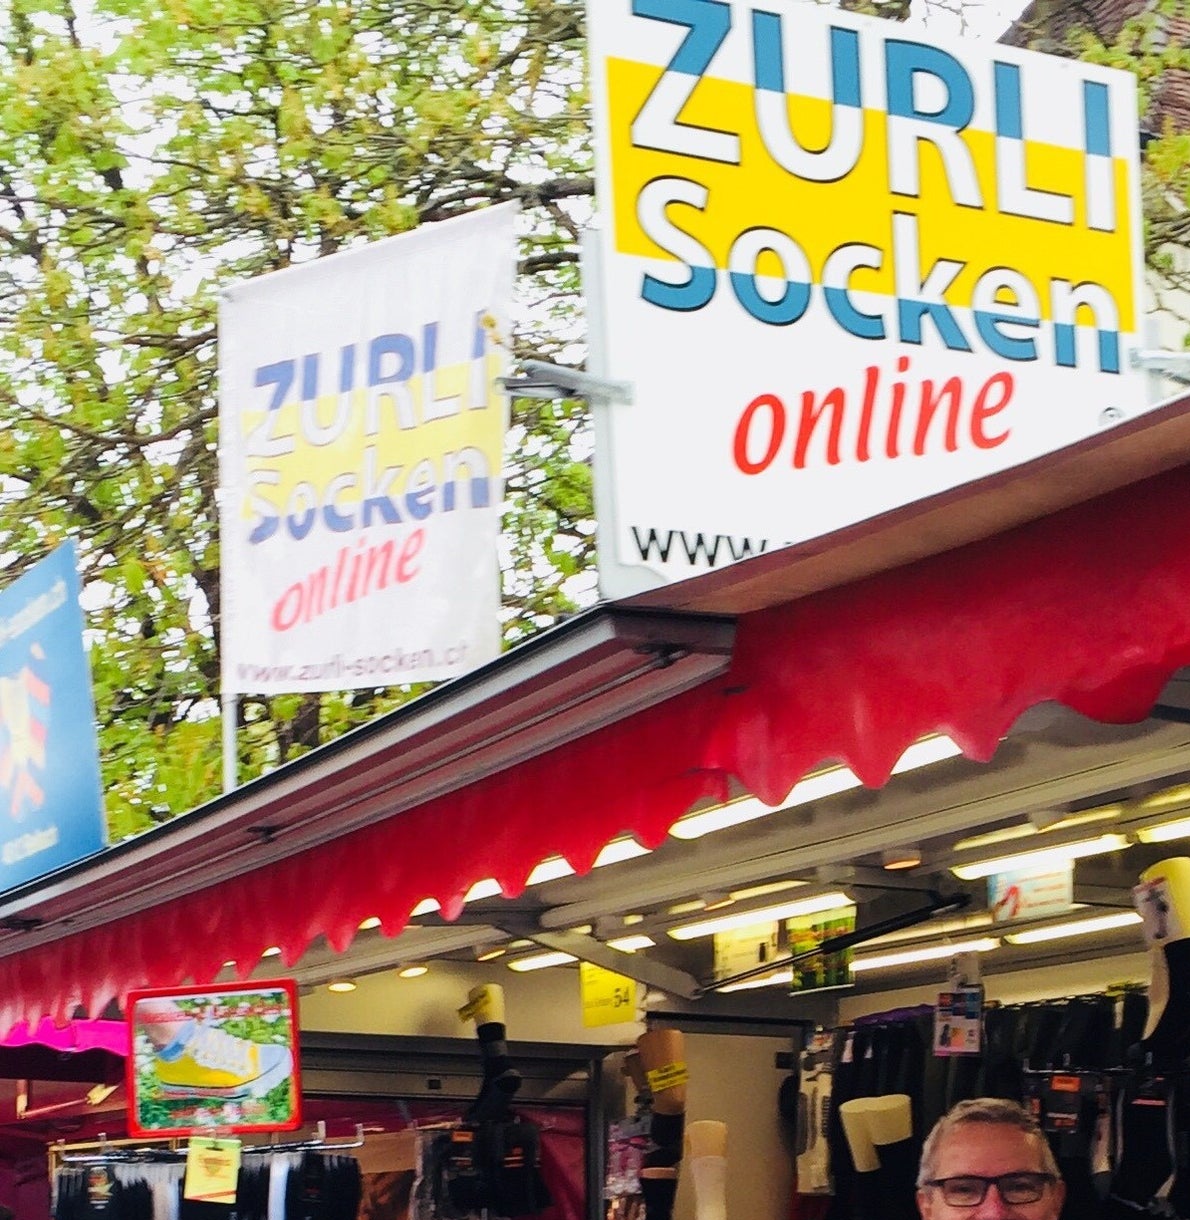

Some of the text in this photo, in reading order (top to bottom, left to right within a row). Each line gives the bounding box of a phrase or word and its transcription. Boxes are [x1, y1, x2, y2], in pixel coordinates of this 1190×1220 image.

[631, 0, 1115, 233] ZURLI
[636, 175, 1121, 374] Socken
[246, 309, 488, 458] ZURLI
[731, 356, 1015, 475] online
[247, 445, 490, 545] Socken
[269, 527, 426, 633] online
